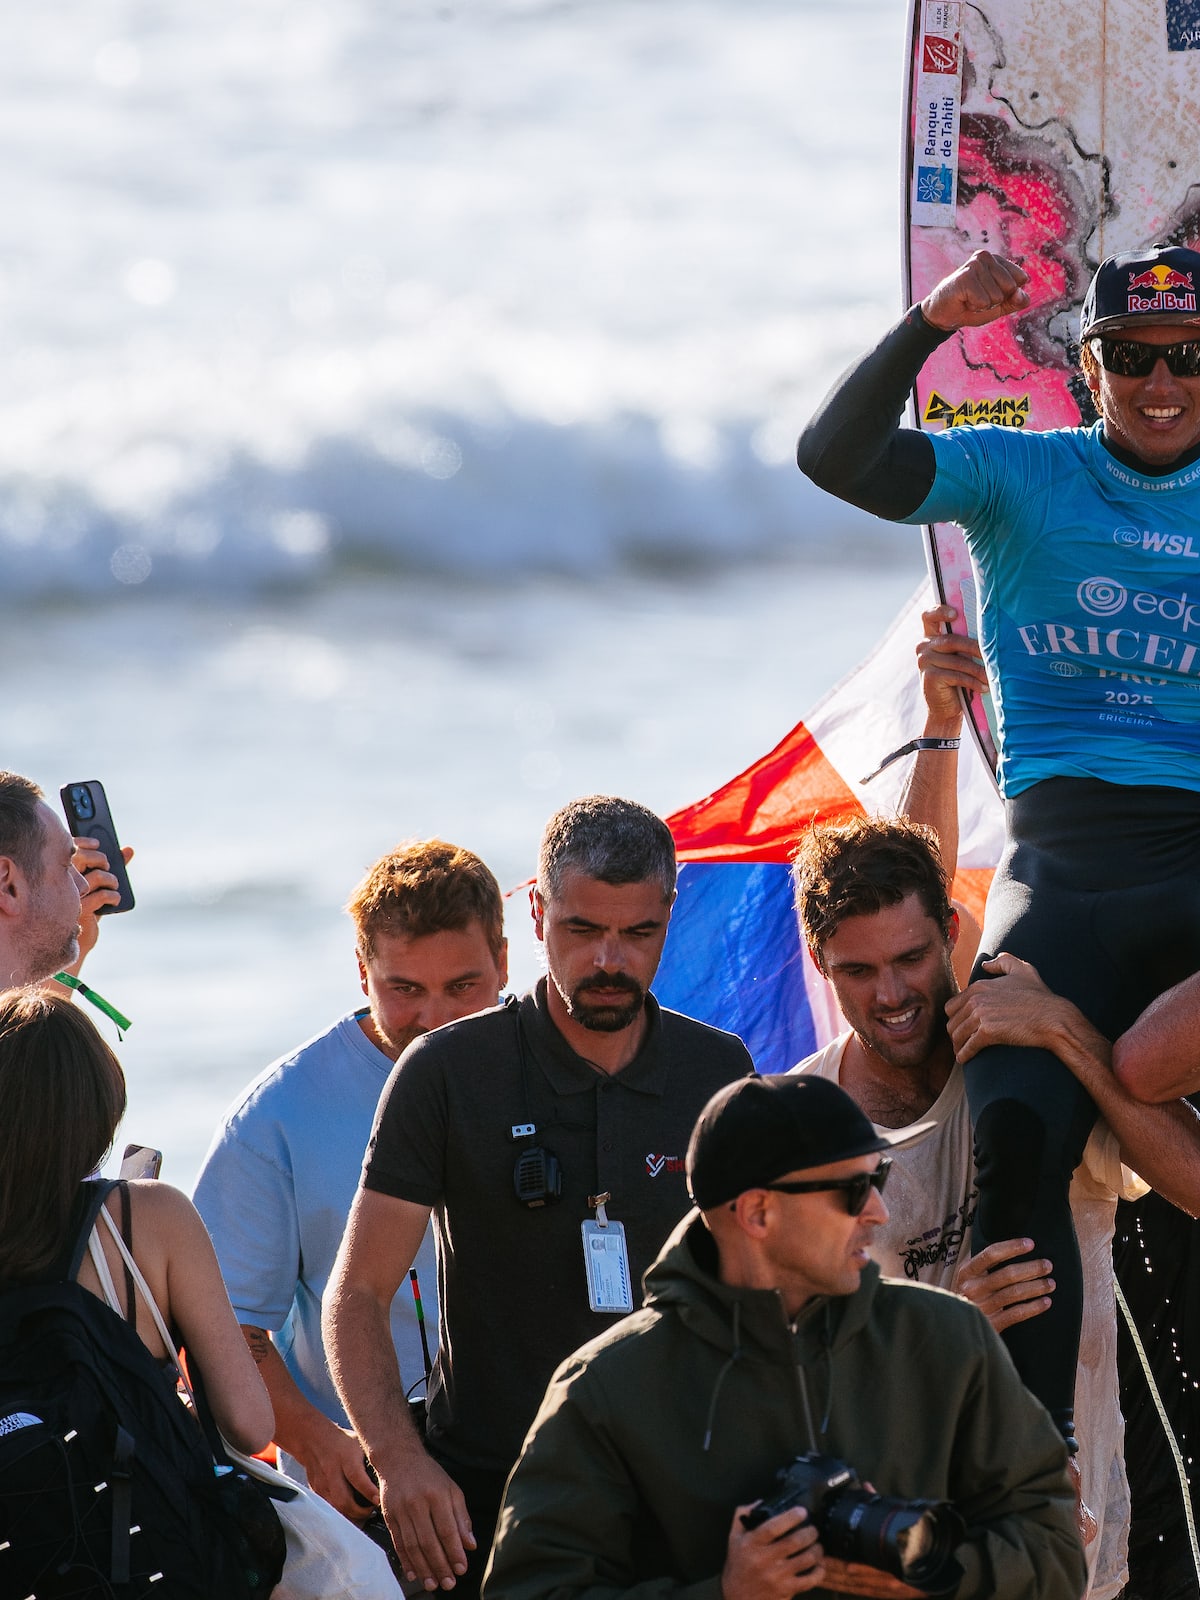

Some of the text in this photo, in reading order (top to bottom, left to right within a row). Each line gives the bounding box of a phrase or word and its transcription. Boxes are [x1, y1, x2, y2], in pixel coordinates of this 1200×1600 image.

[924, 102, 940, 155] Banque
[940, 97, 954, 157] de Tahiti
[1128, 292, 1197, 312] Red Bull
[1105, 460, 1140, 488] WORLD
[1142, 479, 1177, 491] SURF
[1142, 531, 1200, 558] WSL
[1105, 690, 1153, 705] 2025
[1098, 713, 1153, 727] ERICEIRA
